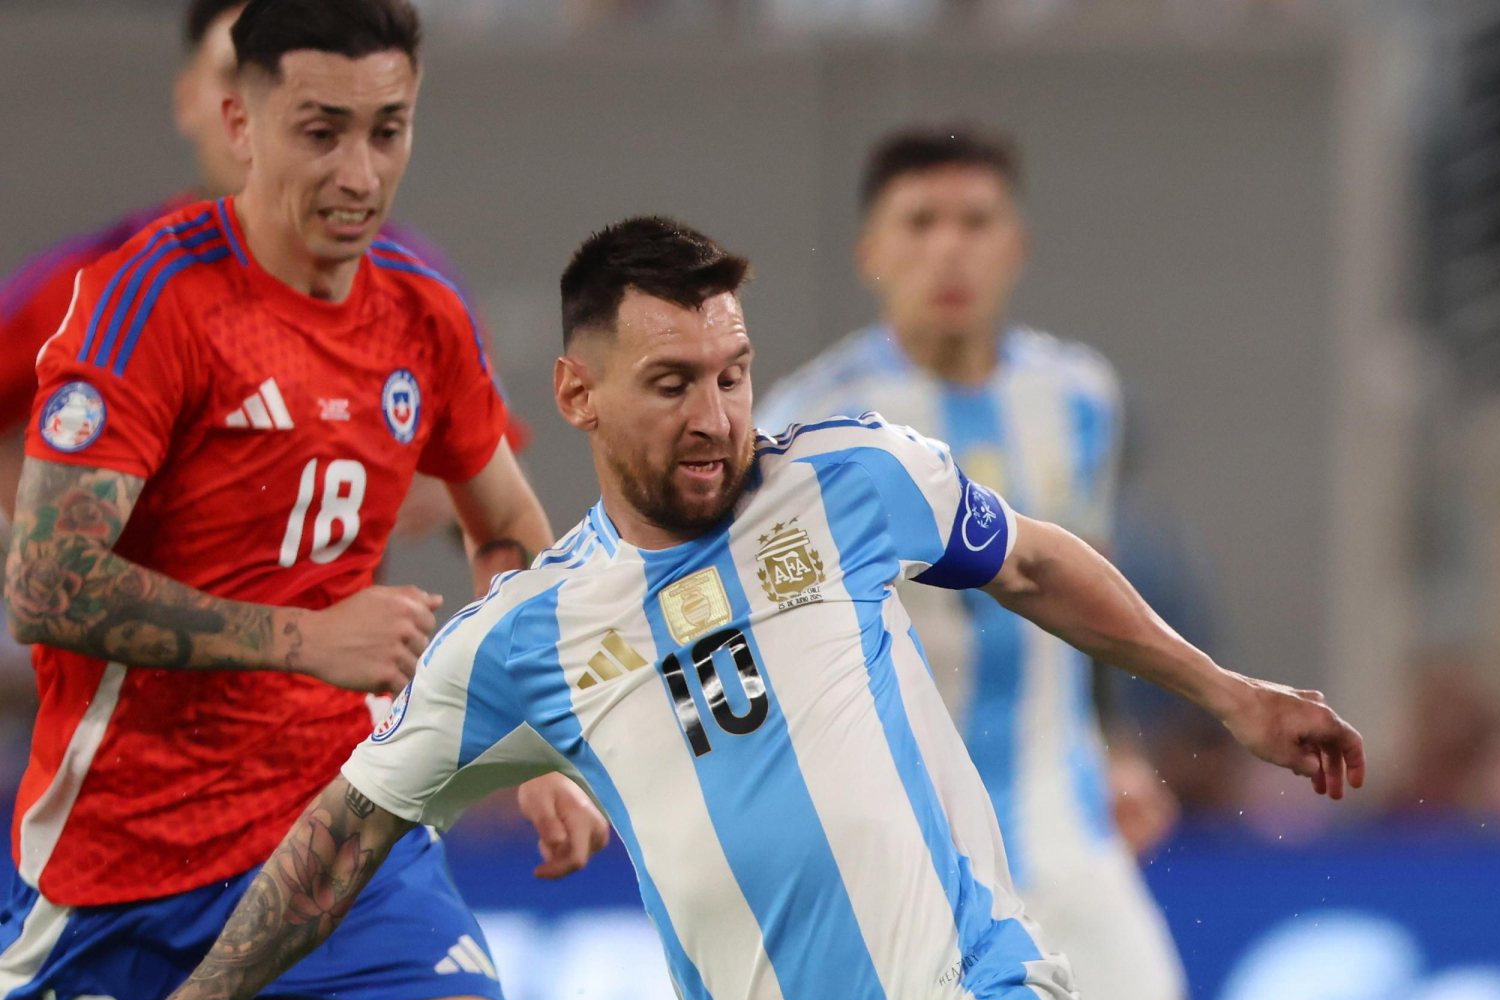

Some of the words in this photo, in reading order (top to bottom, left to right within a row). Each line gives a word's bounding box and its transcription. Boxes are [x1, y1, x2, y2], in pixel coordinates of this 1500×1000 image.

[278, 457, 367, 568] 18
[772, 551, 812, 585] AFA
[662, 628, 769, 758] 10
